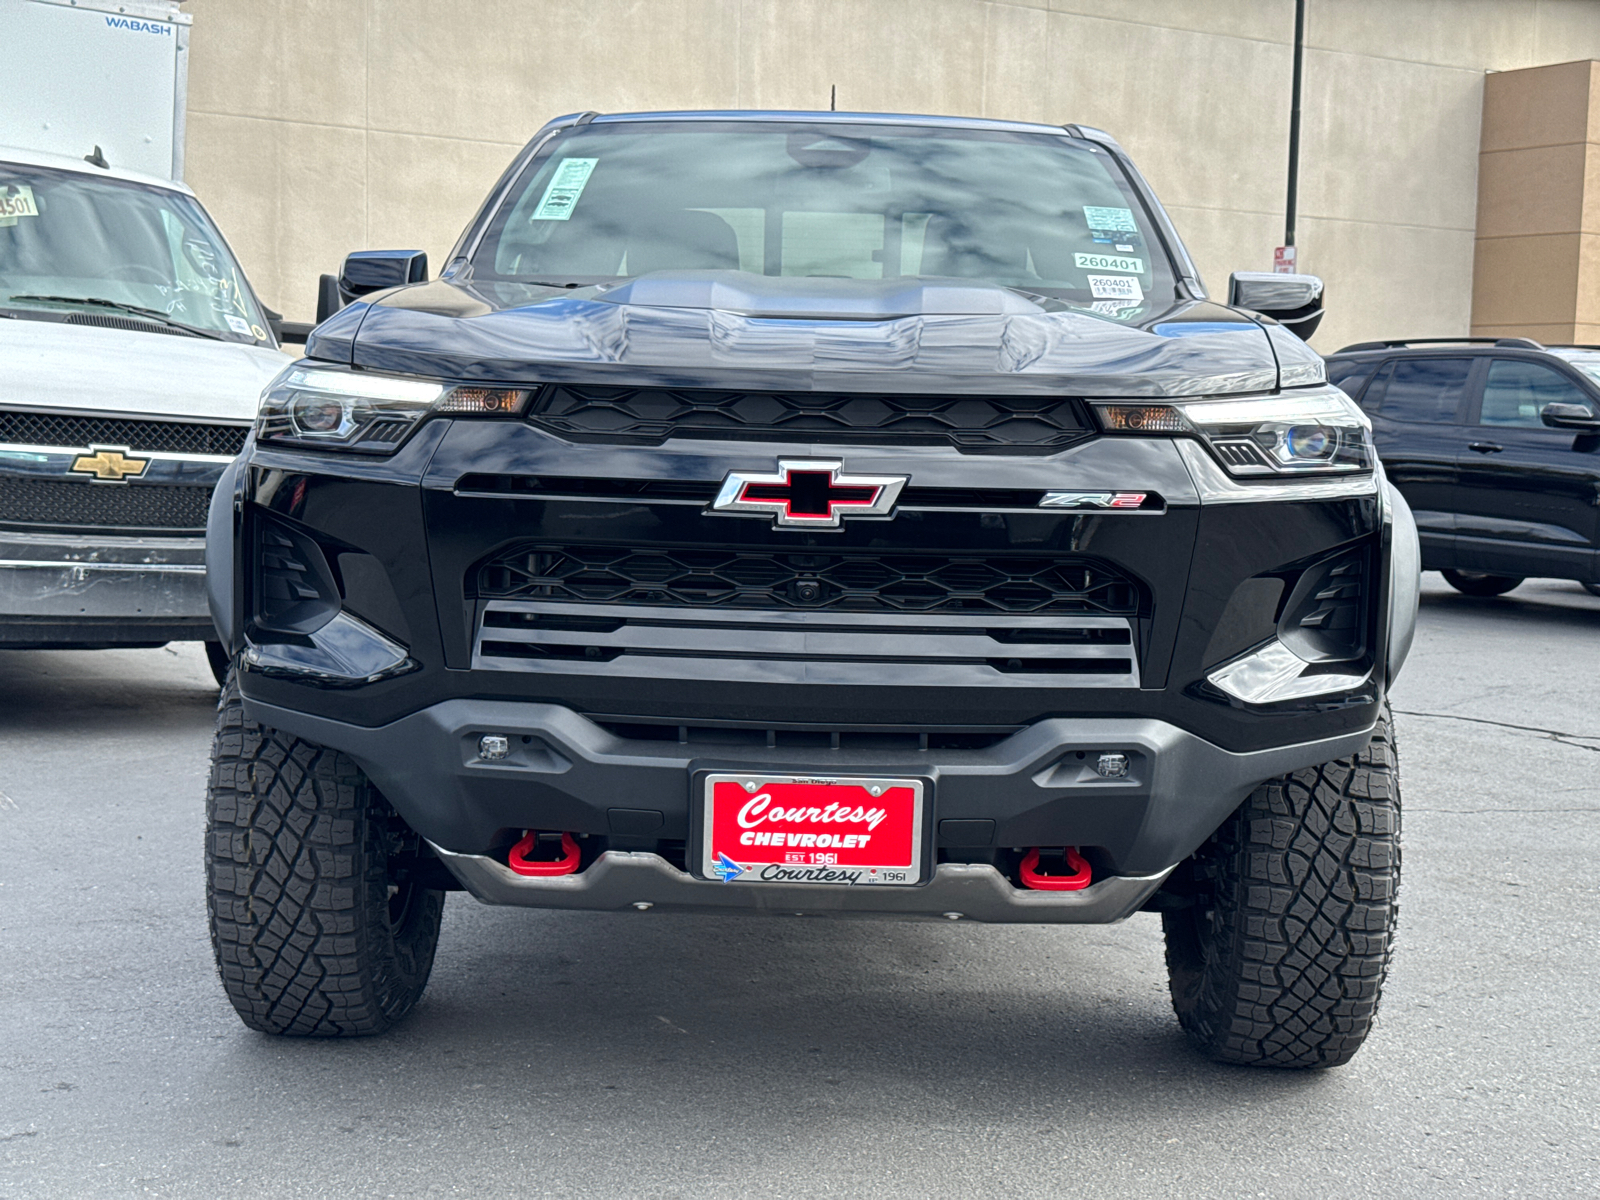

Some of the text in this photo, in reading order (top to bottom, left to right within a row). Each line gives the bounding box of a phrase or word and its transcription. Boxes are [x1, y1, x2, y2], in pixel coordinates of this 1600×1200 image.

[105, 16, 171, 36] WABASH
[1079, 256, 1138, 271] 260401
[1039, 493, 1147, 508] ZR2
[737, 793, 887, 832] Courtesy
[740, 831, 872, 849] CHEVROLET
[785, 852, 838, 864] EST 1961
[760, 864, 863, 886] Courtesy
[883, 872, 906, 881] 1961
